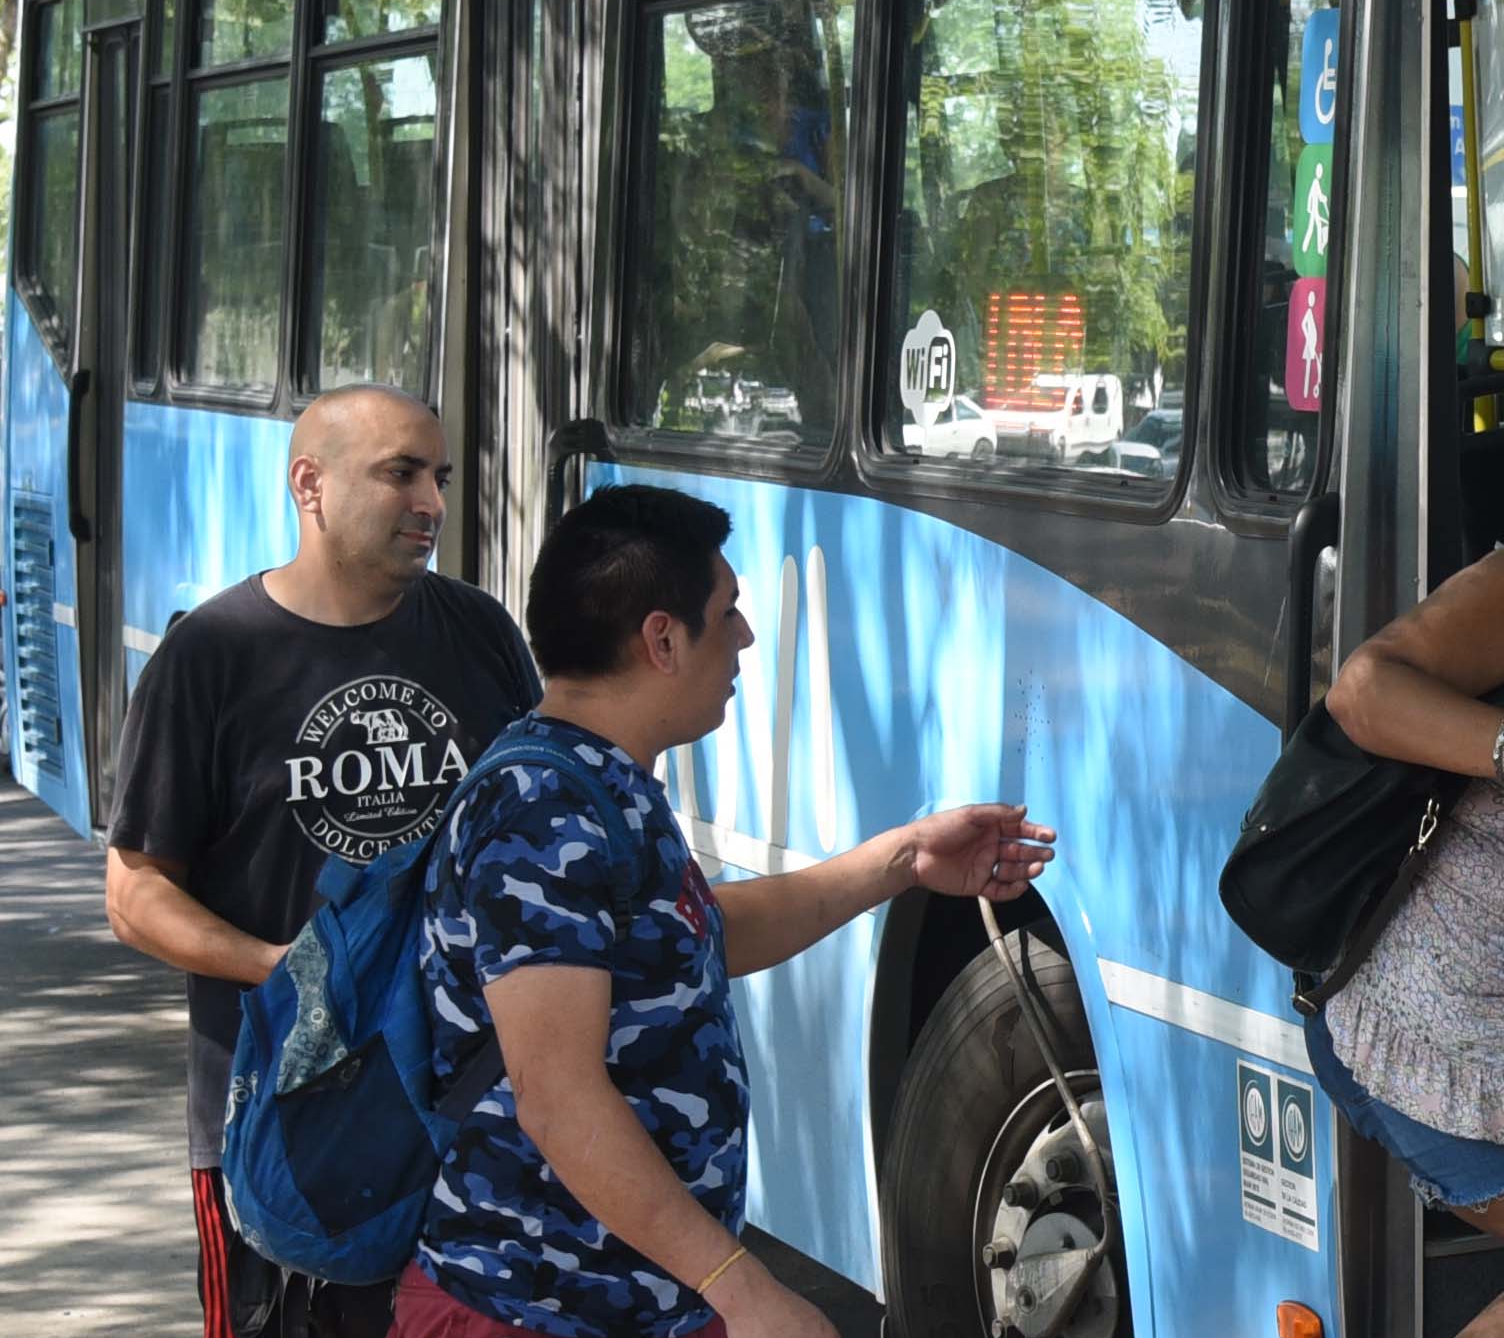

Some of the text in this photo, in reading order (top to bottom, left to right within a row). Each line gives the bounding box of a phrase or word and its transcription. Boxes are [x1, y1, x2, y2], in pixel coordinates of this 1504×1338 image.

[303, 682, 447, 744] WELCOME TO
[285, 738, 470, 802] ROMA
[357, 791, 405, 808] ITALIA
